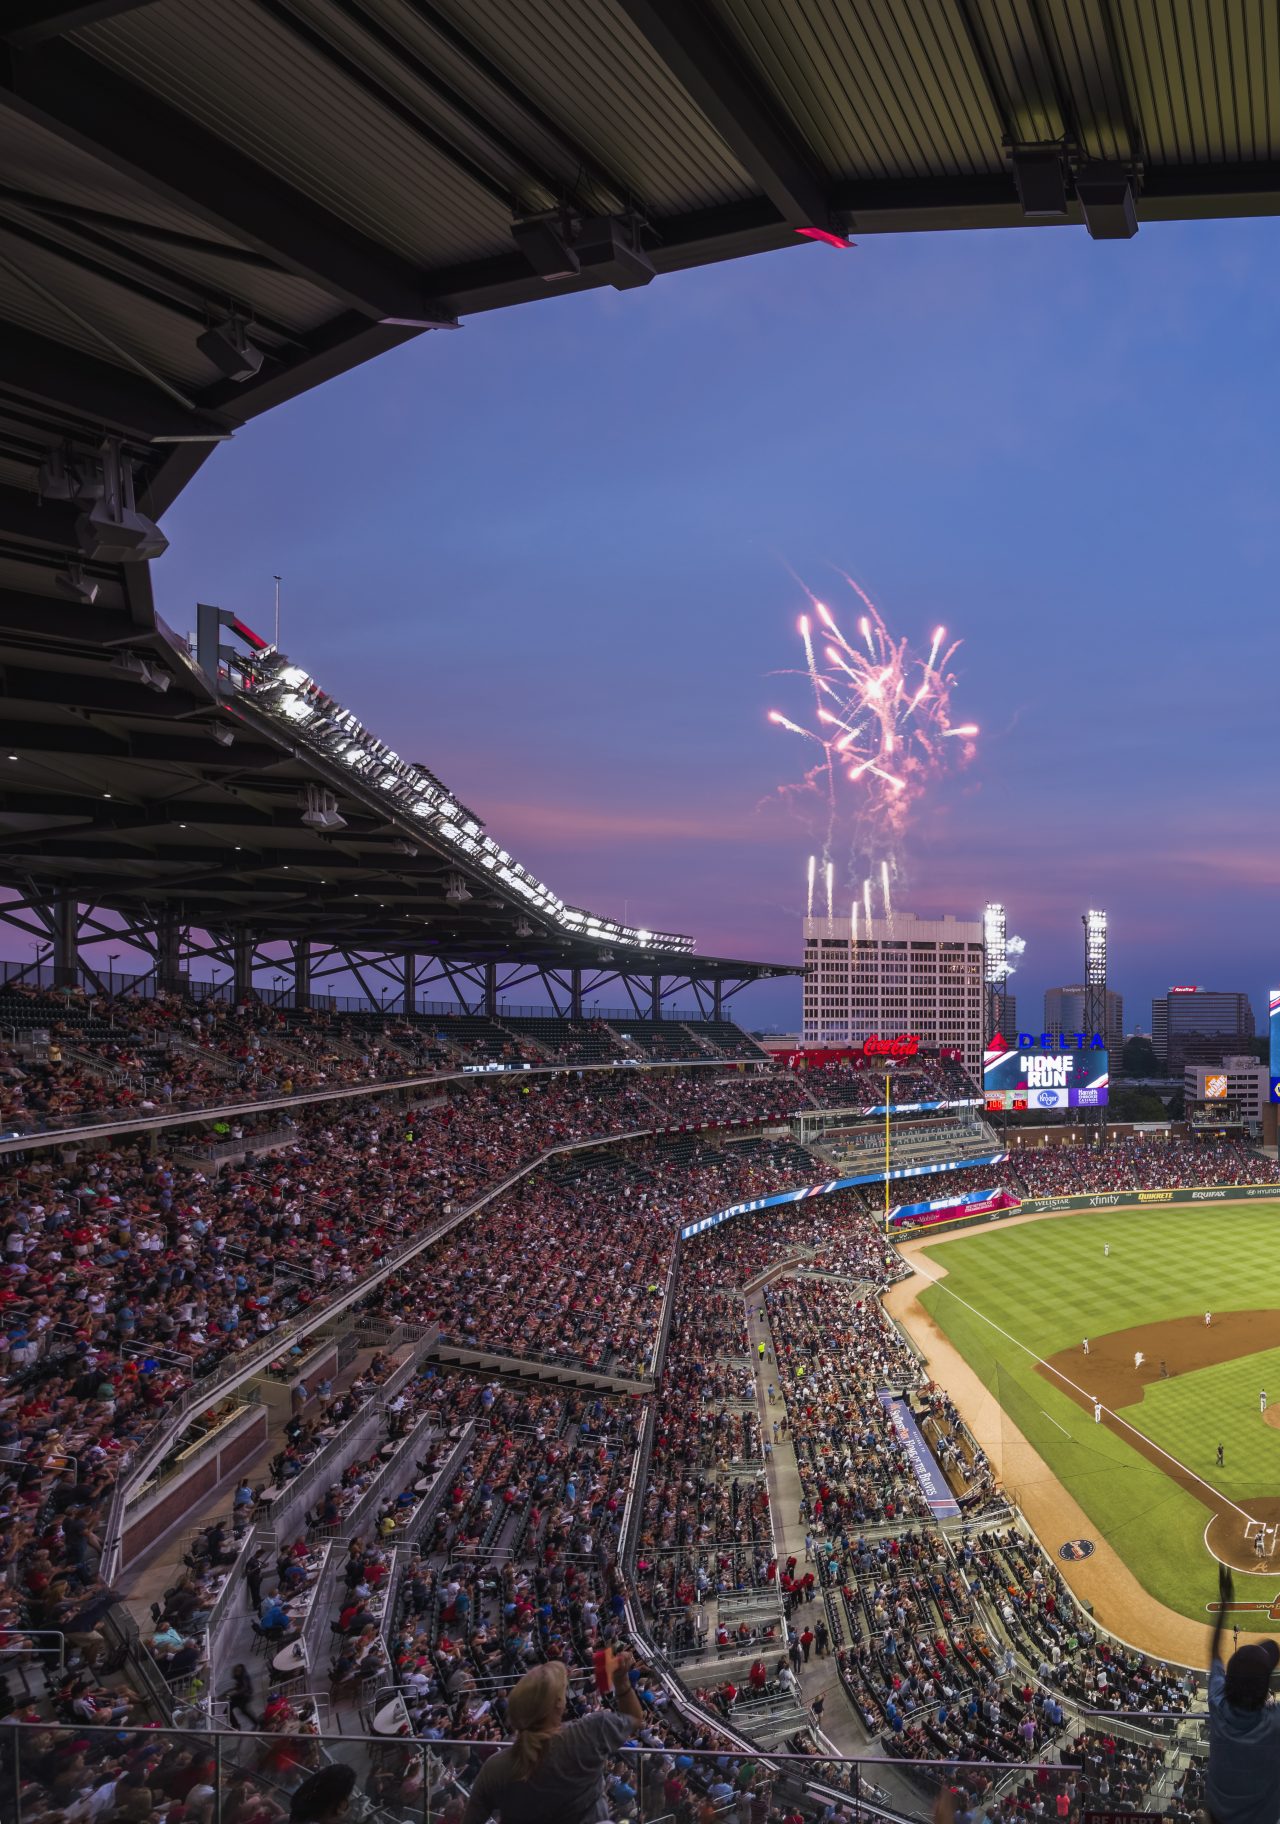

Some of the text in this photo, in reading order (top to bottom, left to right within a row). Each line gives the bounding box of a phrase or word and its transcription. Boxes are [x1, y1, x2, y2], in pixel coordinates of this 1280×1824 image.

[1018, 1033, 1105, 1049] DELTA
[1020, 1055, 1074, 1072] HOME
[1027, 1071, 1067, 1087] RUN
[1039, 1092, 1057, 1105] Kroger
[1089, 1195, 1119, 1206] xfinity
[1192, 1191, 1226, 1200] EQUIFAX
[919, 1471, 937, 1496] BRAVES
